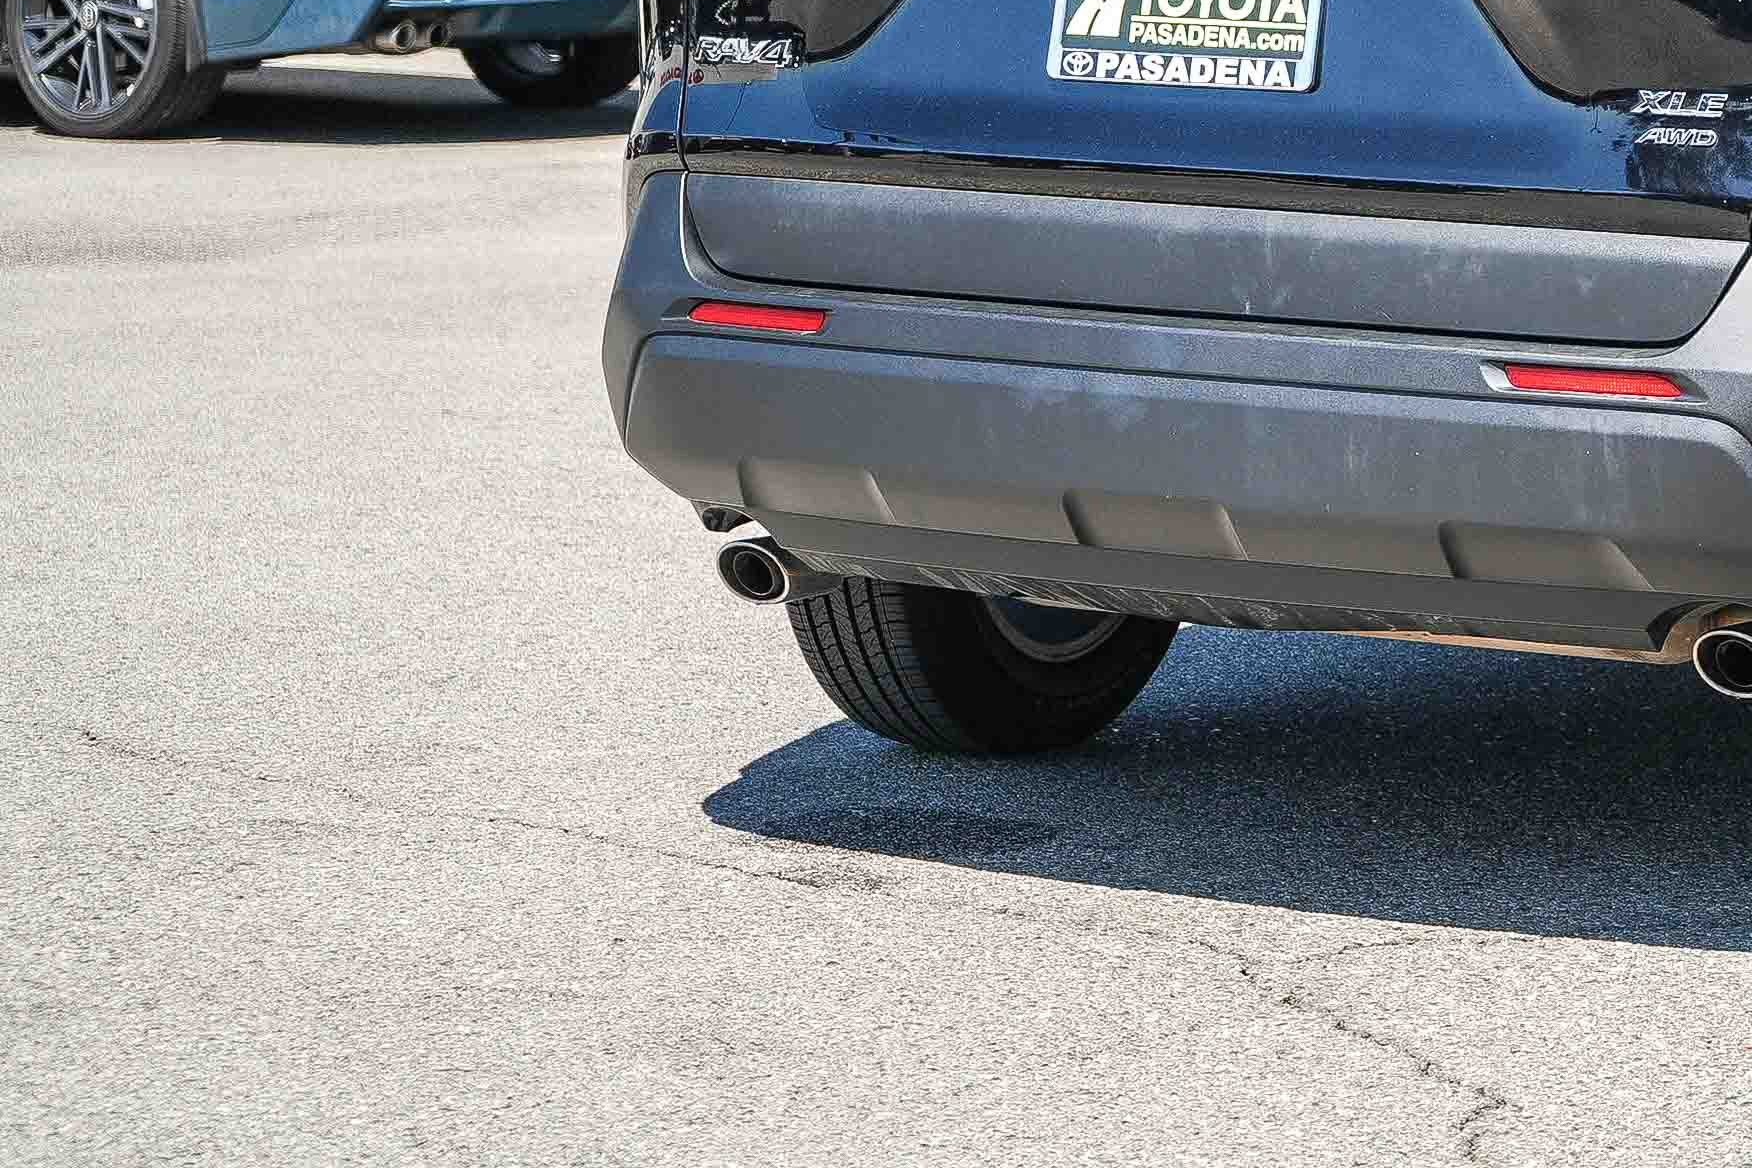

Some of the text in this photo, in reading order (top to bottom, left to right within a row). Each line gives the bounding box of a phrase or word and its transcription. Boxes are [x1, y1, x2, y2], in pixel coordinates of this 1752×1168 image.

[694, 36, 792, 68] RAV4
[1129, 23, 1305, 52] PASADENA.com
[1096, 54, 1291, 87] PASADENA
[1631, 89, 1728, 118] XLE
[1634, 127, 1718, 147] AWD
